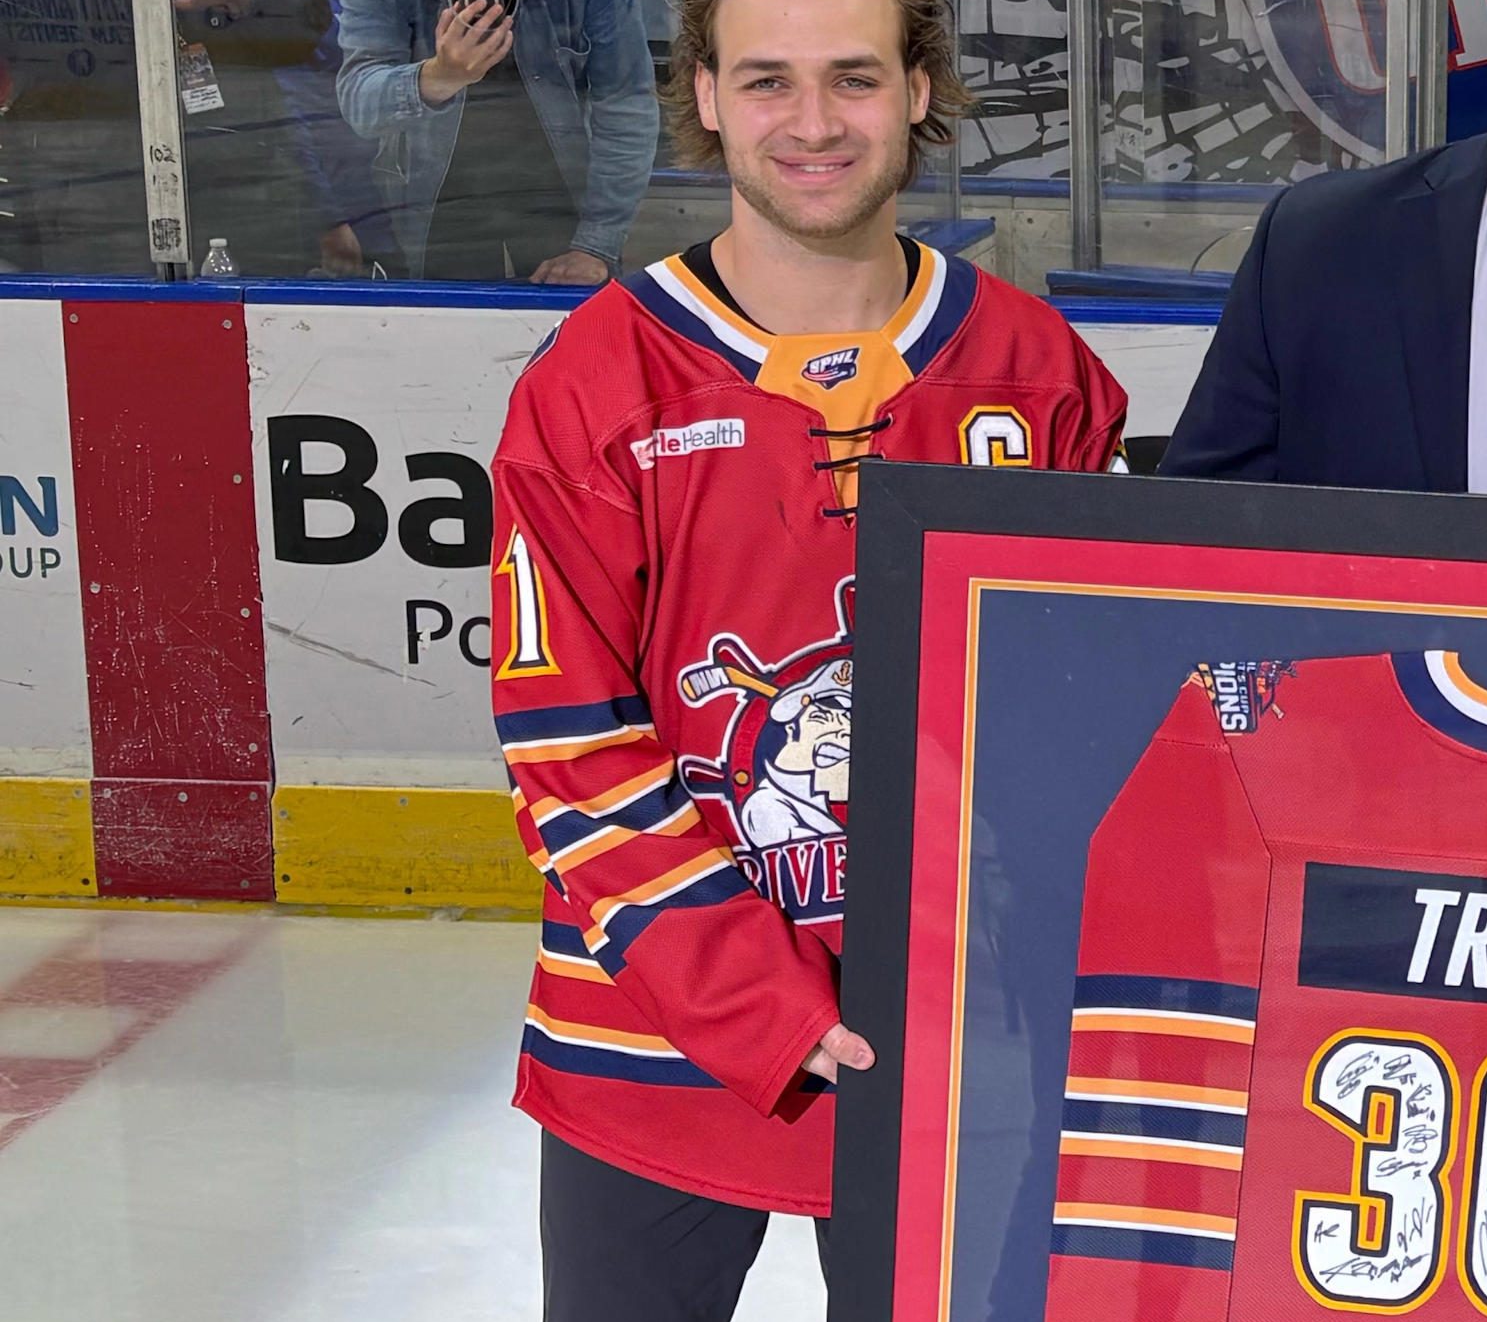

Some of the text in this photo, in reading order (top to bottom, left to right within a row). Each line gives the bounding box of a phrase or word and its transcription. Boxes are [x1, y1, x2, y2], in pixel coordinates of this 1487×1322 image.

[149, 143, 177, 164] 102
[808, 349, 857, 375] SPHL
[266, 414, 493, 569] Ba
[406, 598, 491, 668] Po
